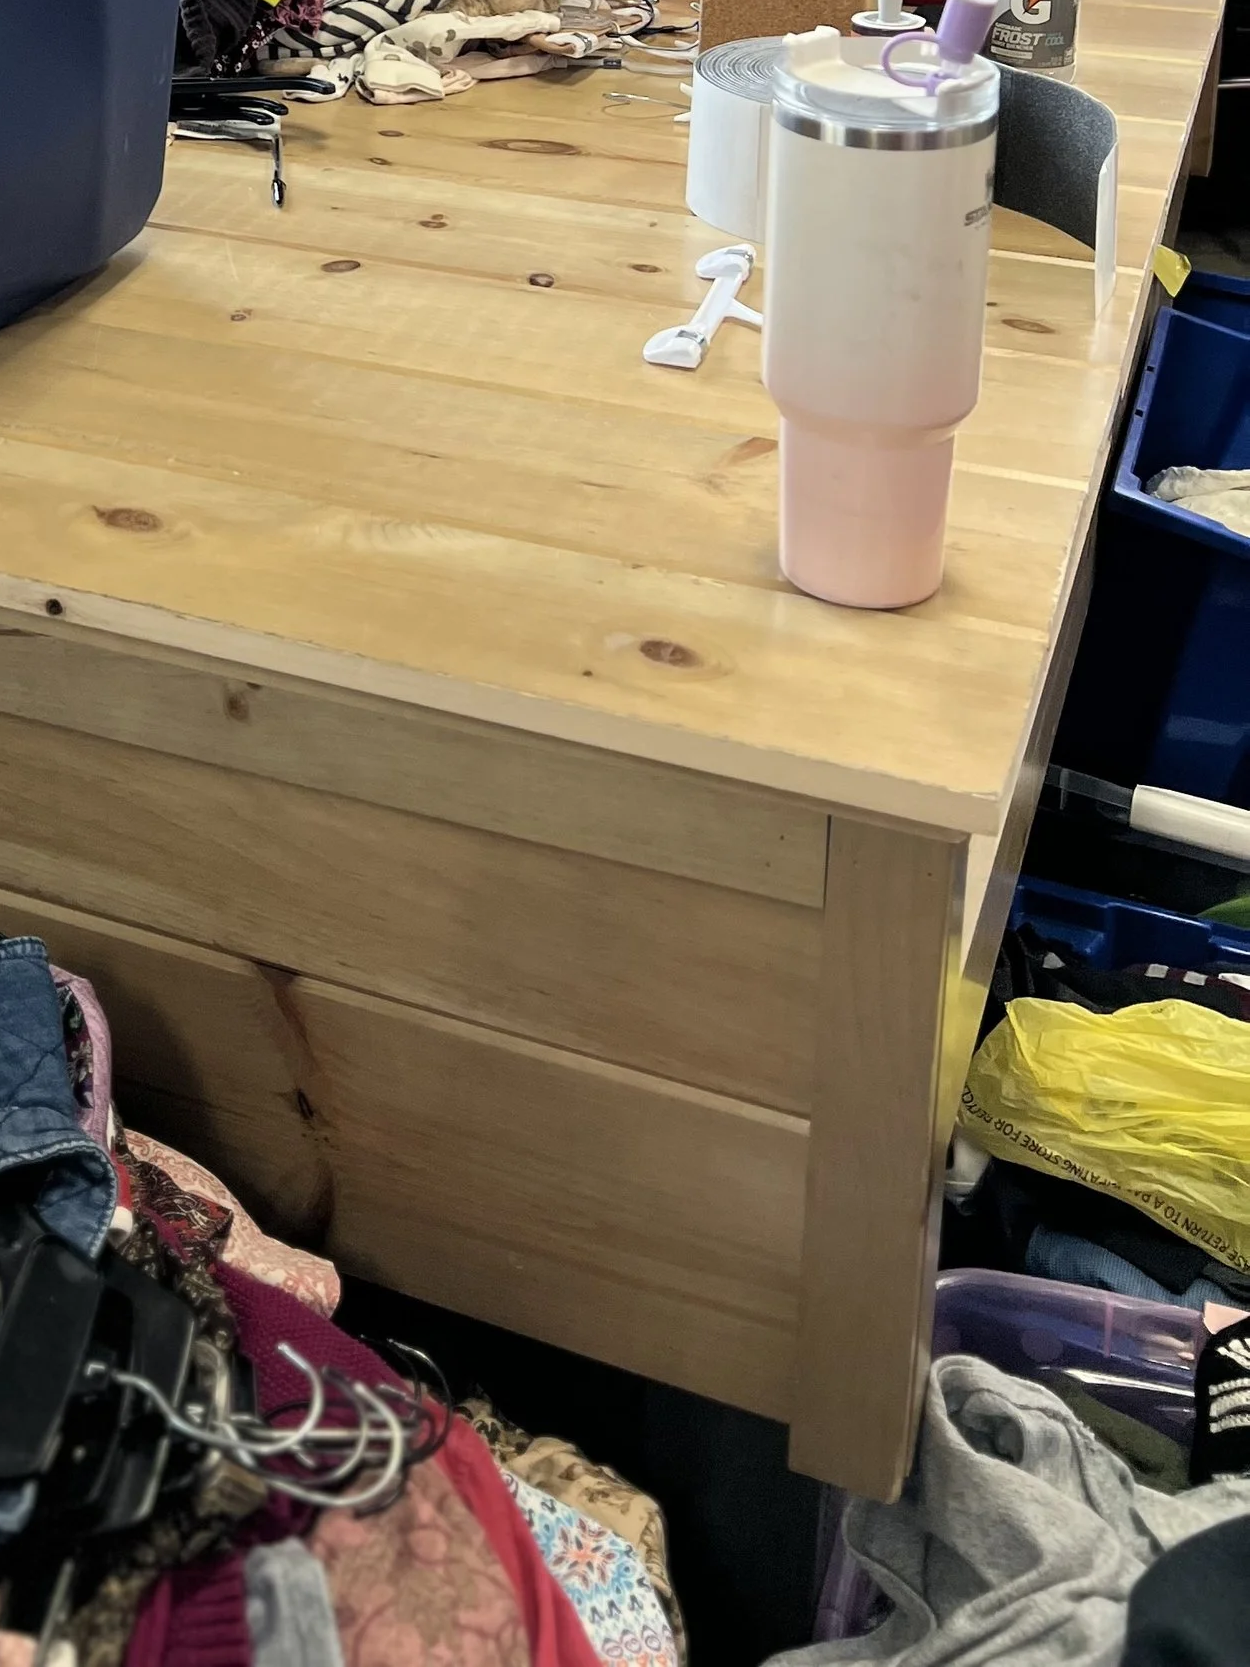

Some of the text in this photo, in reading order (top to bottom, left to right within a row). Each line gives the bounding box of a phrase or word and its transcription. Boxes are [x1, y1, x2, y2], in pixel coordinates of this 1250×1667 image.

[992, 26, 1046, 46] FROST
[994, 1118, 1022, 1143] FOR
[1019, 1134, 1060, 1165] STORE
[1153, 1196, 1166, 1210] A
[1164, 1205, 1183, 1225] TO
[1181, 1217, 1231, 1253] RETURN
